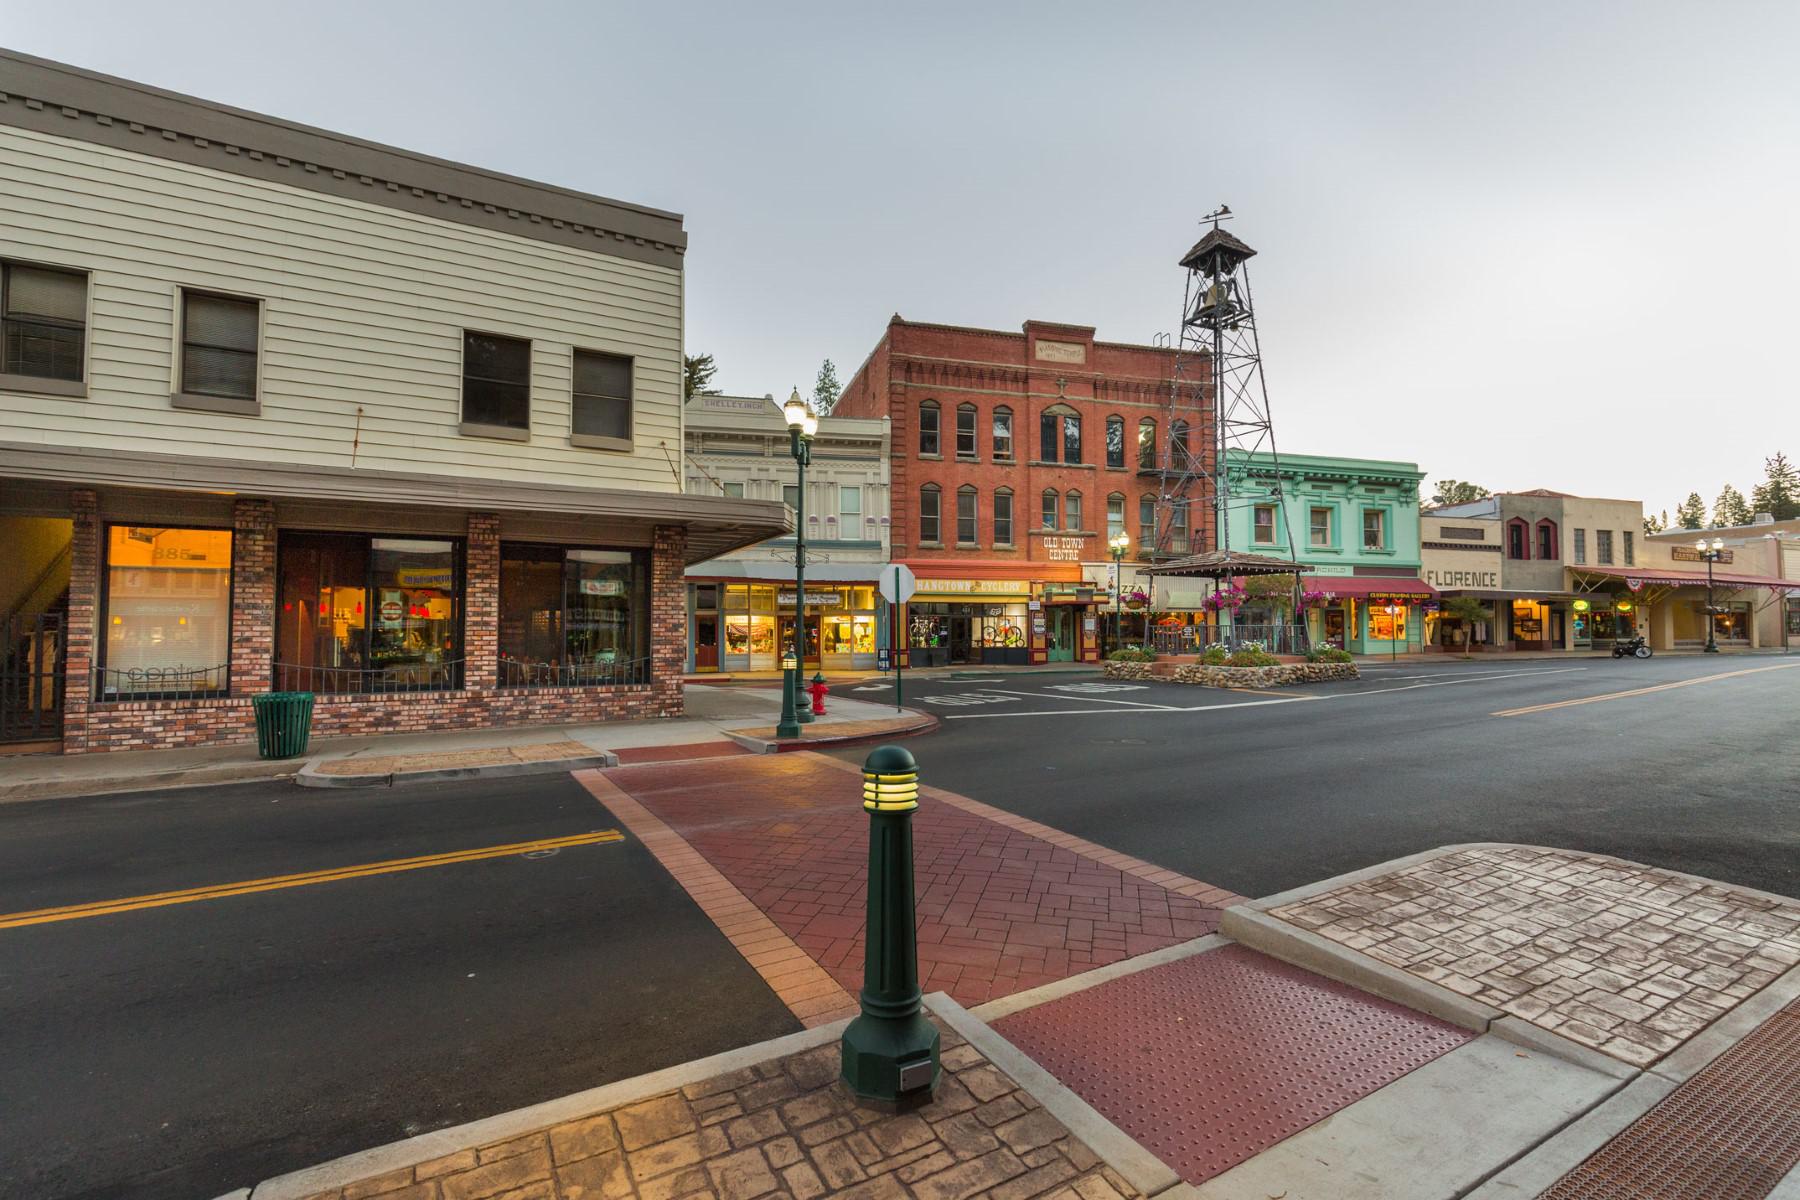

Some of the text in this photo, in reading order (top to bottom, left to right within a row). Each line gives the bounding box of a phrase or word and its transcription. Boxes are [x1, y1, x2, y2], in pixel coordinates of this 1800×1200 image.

[1043, 536, 1085, 549] OLD TOWN
[1049, 549, 1079, 561] CENTRE
[917, 579, 1021, 592] HANGTOWN CYCLERY
[1427, 570, 1497, 588] FLORENCE
[1121, 584, 1145, 594] ZZA
